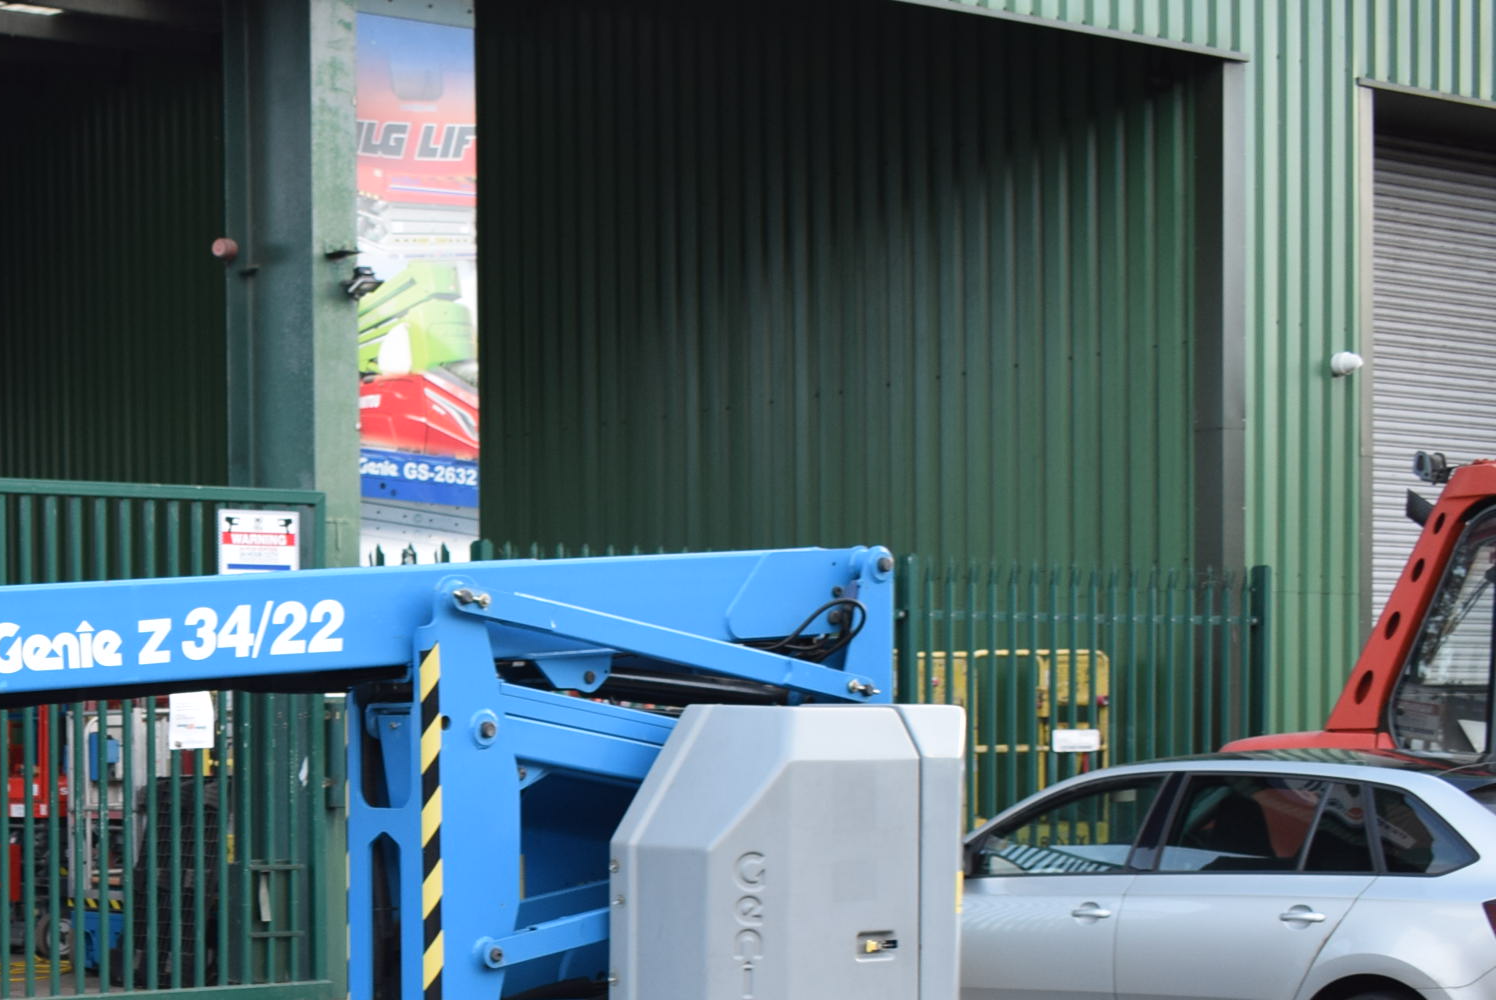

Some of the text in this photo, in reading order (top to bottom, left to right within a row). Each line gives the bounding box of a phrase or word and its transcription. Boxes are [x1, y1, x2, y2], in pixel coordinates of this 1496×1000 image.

[403, 461, 478, 486] GS-2632
[231, 533, 287, 546] WARNING
[137, 617, 172, 665] Z
[181, 599, 346, 661] 34/22
